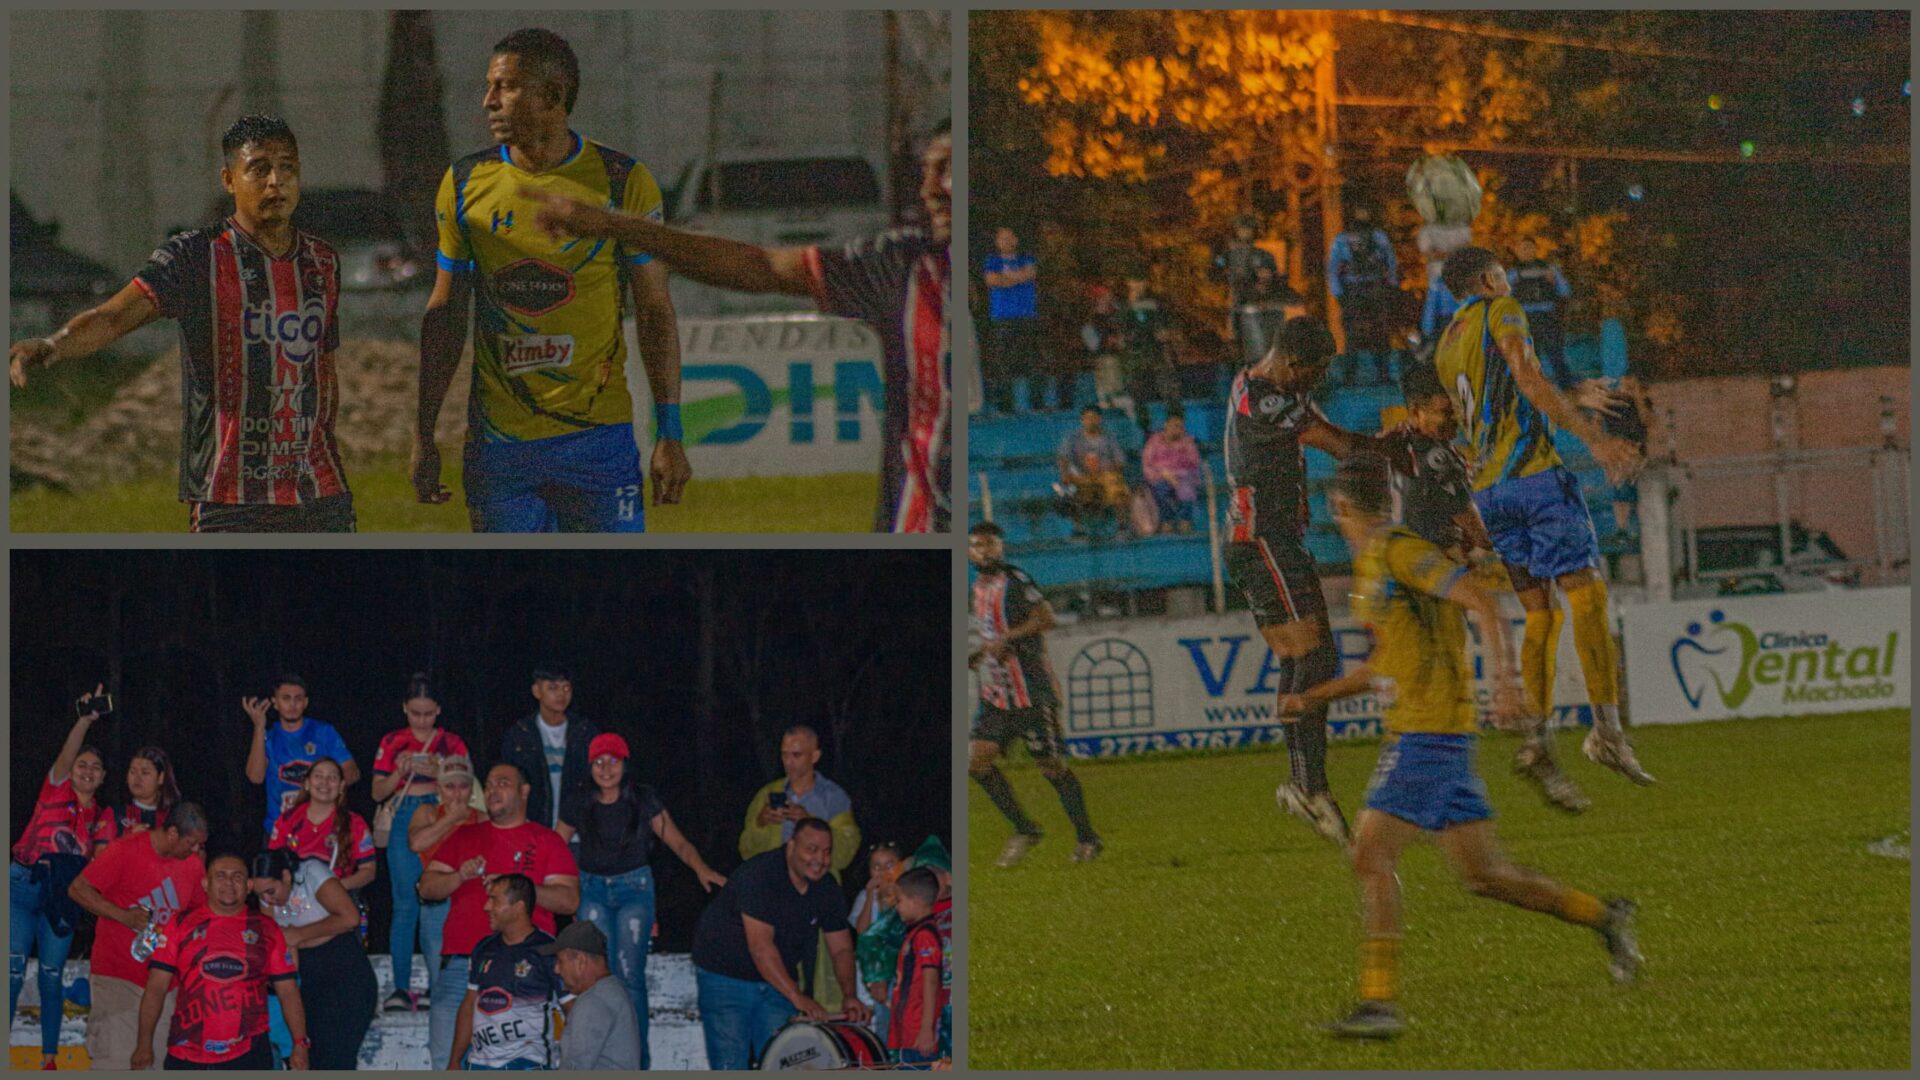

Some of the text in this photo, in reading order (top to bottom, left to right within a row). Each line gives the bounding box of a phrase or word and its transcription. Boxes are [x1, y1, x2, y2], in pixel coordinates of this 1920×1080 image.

[684, 322, 872, 353] IENDAS
[504, 338, 571, 364] Kimby
[243, 416, 285, 434] DON
[1783, 680, 1896, 703] Machado
